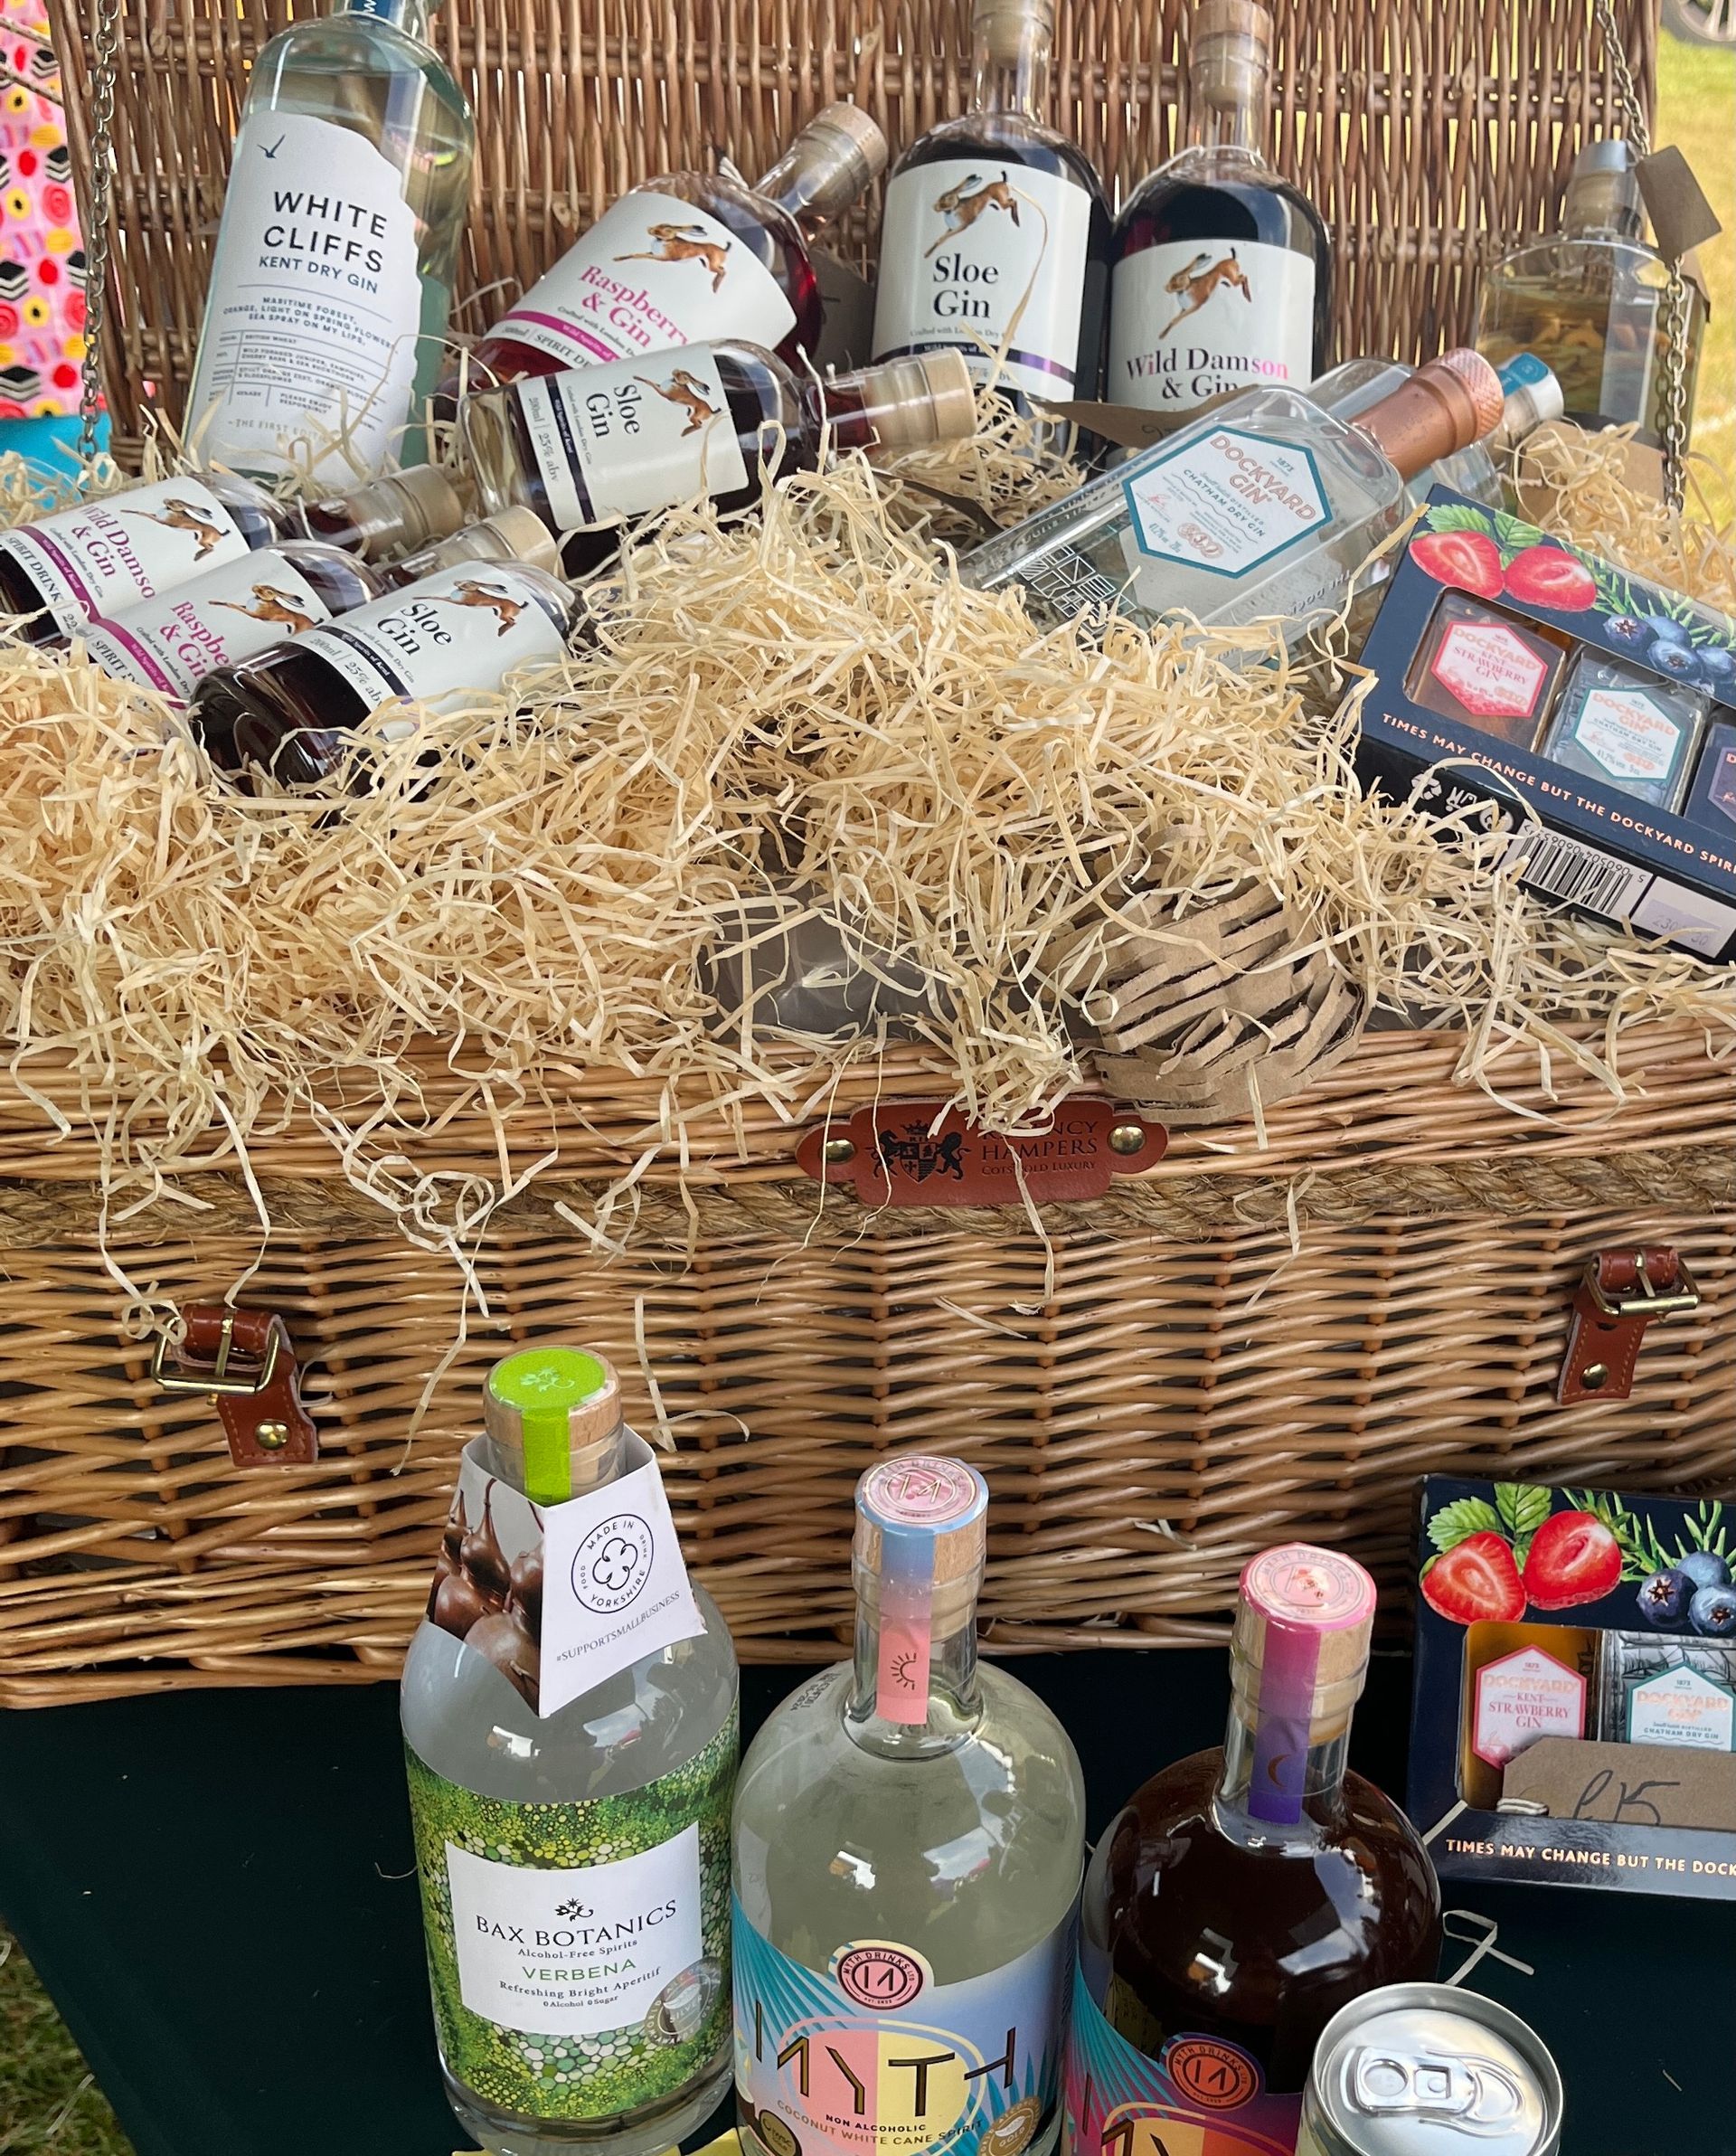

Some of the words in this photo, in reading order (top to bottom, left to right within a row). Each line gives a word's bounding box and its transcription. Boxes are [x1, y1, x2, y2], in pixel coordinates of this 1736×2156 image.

[274, 191, 387, 239] WHITE
[264, 225, 383, 272] CLIFFS
[259, 256, 303, 270] KENT
[307, 261, 343, 279] DRY
[347, 273, 378, 294] GIN
[933, 253, 998, 285] Sloe
[261, 305, 290, 314] LIGHT
[295, 308, 309, 317] ON
[314, 312, 351, 330] SPRING
[263, 297, 312, 309] MARITIME
[316, 305, 357, 325] FOREST,
[581, 291, 606, 314] &
[609, 306, 651, 347] Gin
[933, 289, 991, 319] Gin
[269, 314, 299, 325] SPRAY
[304, 320, 318, 328] ON
[323, 325, 337, 335] MY
[534, 334, 574, 357] SPIRIT
[1127, 348, 1176, 380] Wild
[1186, 348, 1288, 380] Damson
[1162, 376, 1183, 400] &
[1192, 374, 1238, 397] Gin
[586, 393, 613, 438] Gin
[614, 384, 642, 434] Sloe
[547, 460, 560, 481] abv
[1210, 434, 1316, 521] DOCKYARD
[1184, 468, 1227, 506] CHATHAM
[1227, 506, 1248, 523] DRY
[1248, 523, 1266, 537] GIN
[1229, 474, 1268, 506] GIN
[71, 526, 92, 541] &
[87, 540, 116, 577] Gin
[81, 506, 118, 530] Wild
[106, 528, 156, 599] Damso
[5, 537, 33, 561] SPIRIT
[30, 560, 63, 601] DRINK
[61, 613, 78, 630] 22
[159, 624, 181, 642] &
[170, 601, 231, 666] Raspbe
[377, 619, 421, 657] Gin
[401, 603, 452, 646] Sloe
[92, 639, 127, 672] SPIRIT
[1455, 627, 1538, 670] DOCKYARD
[344, 661, 371, 686] 25%
[1454, 646, 1526, 685] STRAWBERRY
[1476, 667, 1499, 682] GIN
[1592, 692, 1675, 736] DOCKYARD
[1382, 713, 1429, 741] TIMES
[1433, 734, 1467, 757] MAY
[1471, 752, 1536, 787] CHANGE
[1541, 781, 1572, 801] BUT
[1577, 796, 1606, 817] THE
[1610, 811, 1694, 854] DOCKYARD
[982, 1138, 1098, 1160] HAMPERS
[982, 1163, 1049, 1176] COTSOLD
[587, 1521, 618, 1550] MADE
[623, 1520, 635, 1529] IN
[590, 1569, 646, 1608] YORKSHIRE
[556, 1590, 681, 1662] #SUPPORTSMALLBUSINESS
[1488, 1701, 1571, 1718] STRAWBERRY
[1517, 1692, 1544, 1702] KENT
[1637, 1690, 1728, 1710] DOCKYARD
[1516, 1716, 1542, 1728] GIN
[1644, 1727, 1682, 1735] CHATHAM
[1446, 1839, 1495, 1855] TIMES
[1501, 1844, 1535, 1859] MAY
[1542, 1848, 1610, 1866] CHANGE
[1617, 1854, 1649, 1868] BUT
[1655, 1857, 1685, 1872] THE
[476, 1914, 524, 1944] BAX
[535, 1899, 676, 1946] BOTANICS
[517, 1947, 595, 1960] Alcohol-Free
[599, 1940, 637, 1955] Spirits
[843, 1954, 862, 1973] MYTH
[865, 1952, 910, 1969] DRINKS
[498, 1980, 564, 2000] Refreshing
[569, 1985, 609, 1999] Bright
[613, 1966, 661, 1991] Aperitif
[522, 1958, 637, 1981] VERBENA
[1175, 2047, 1194, 2066] MYTH
[1199, 2046, 1243, 2071] DRINKS
[778, 2099, 838, 2135] COCONUT
[841, 2130, 887, 2144] WHITE
[892, 2135, 934, 2145] CANE
[939, 2120, 983, 2141] SPIRIT
[826, 2113, 851, 2127] NON
[855, 2123, 926, 2134] ALCOHOLIC
[999, 2126, 1025, 2147] GOLD
